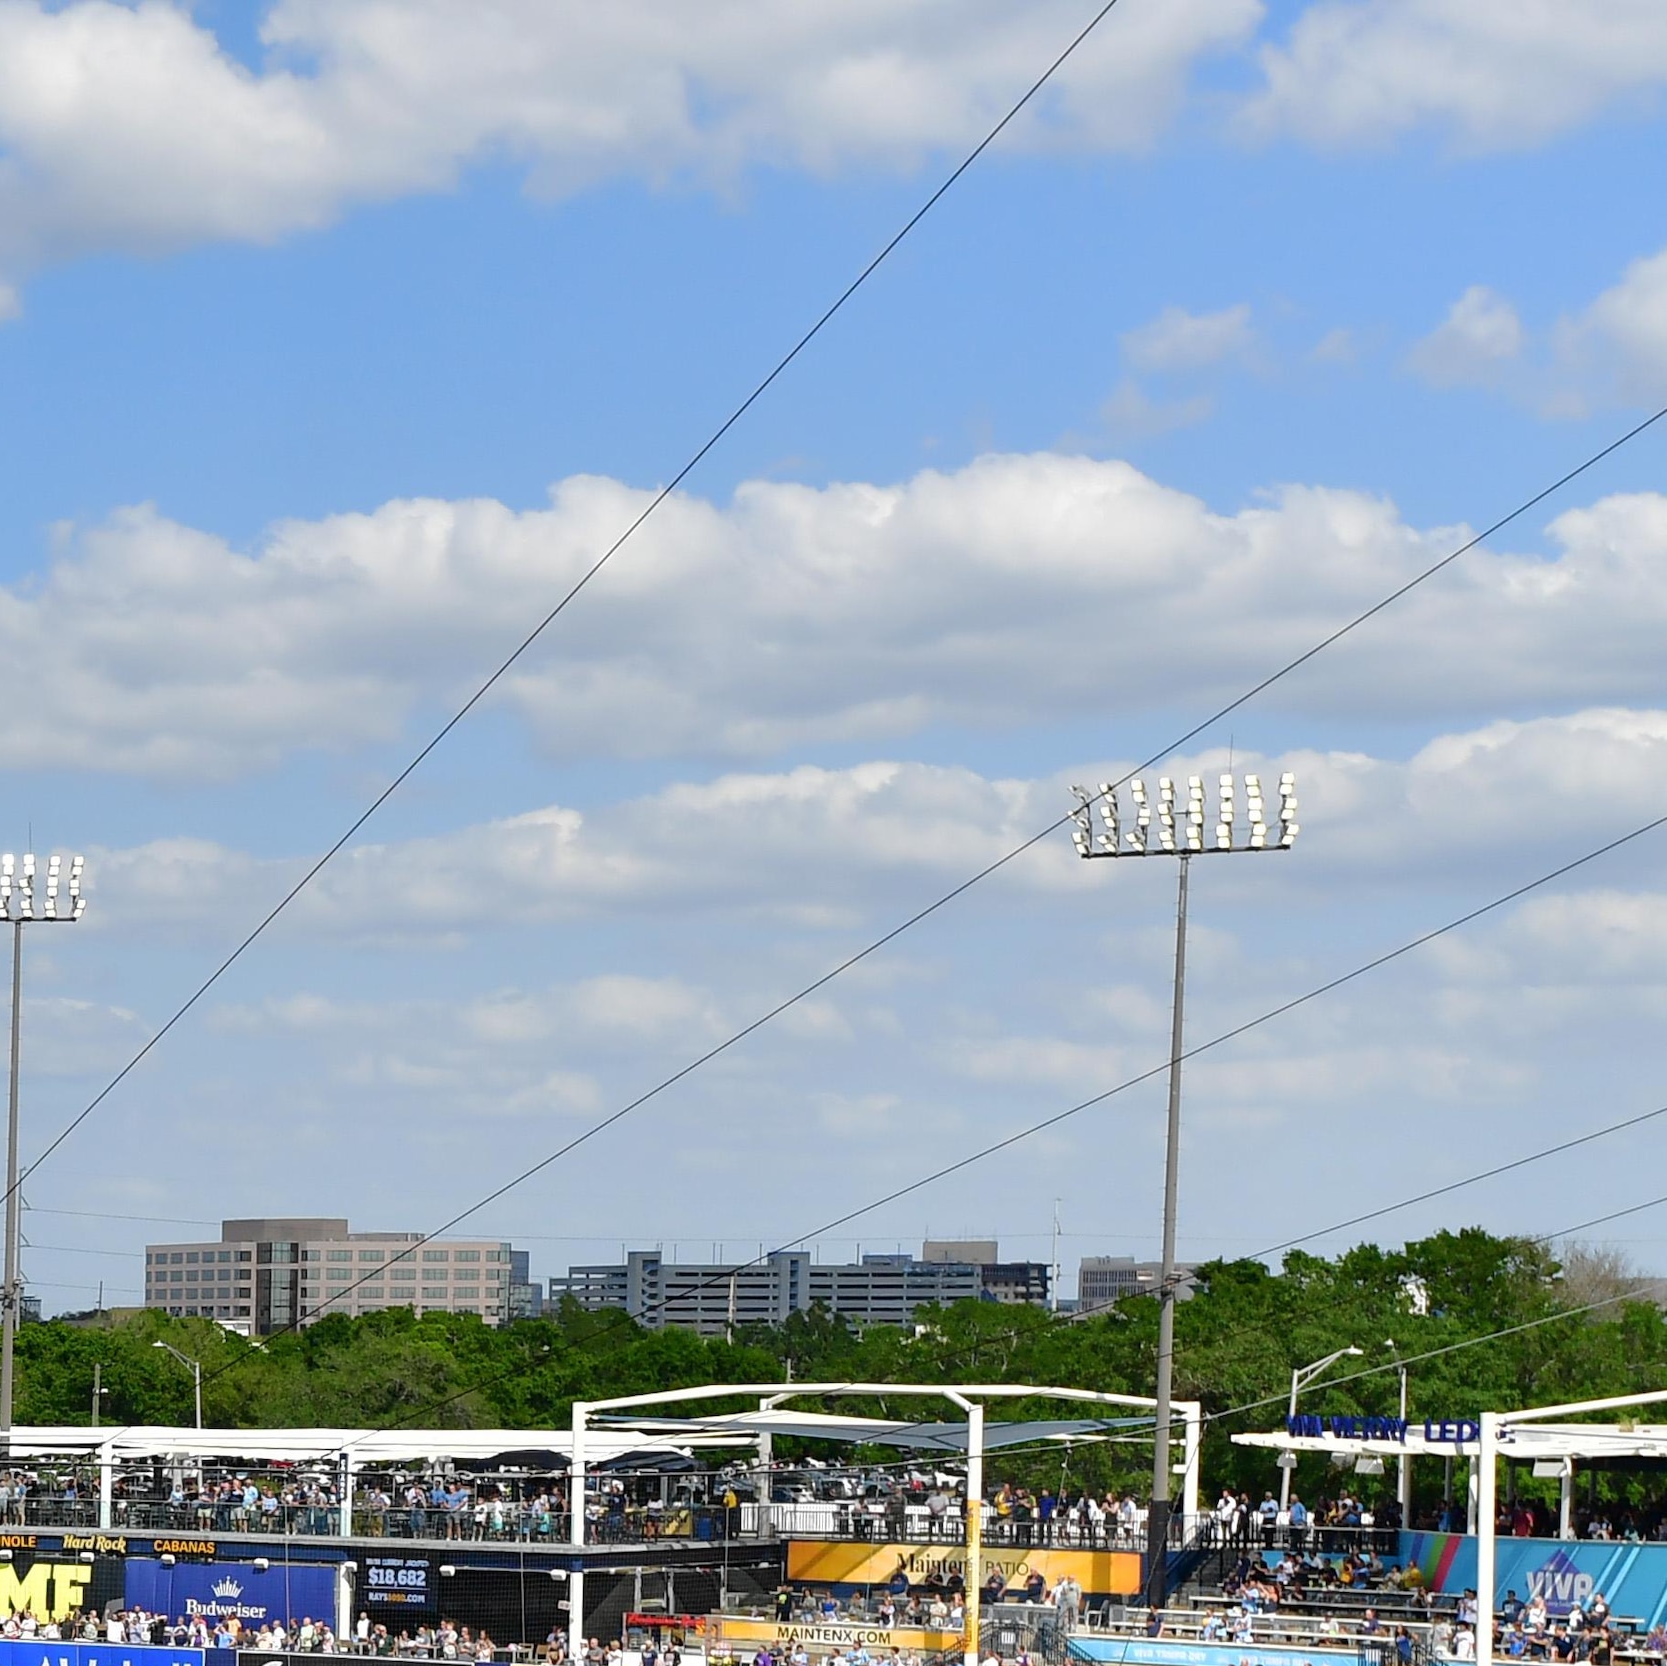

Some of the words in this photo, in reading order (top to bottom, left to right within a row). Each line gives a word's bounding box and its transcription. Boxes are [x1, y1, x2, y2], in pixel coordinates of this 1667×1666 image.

[62, 1534, 94, 1549] Hard
[94, 1535, 127, 1553] Rock
[153, 1539, 216, 1554] CABANAS
[368, 1566, 427, 1588] $18,682
[986, 1560, 1029, 1576] PATIO
[1526, 1570, 1594, 1601] VIVA
[185, 1598, 267, 1620] Budweiser
